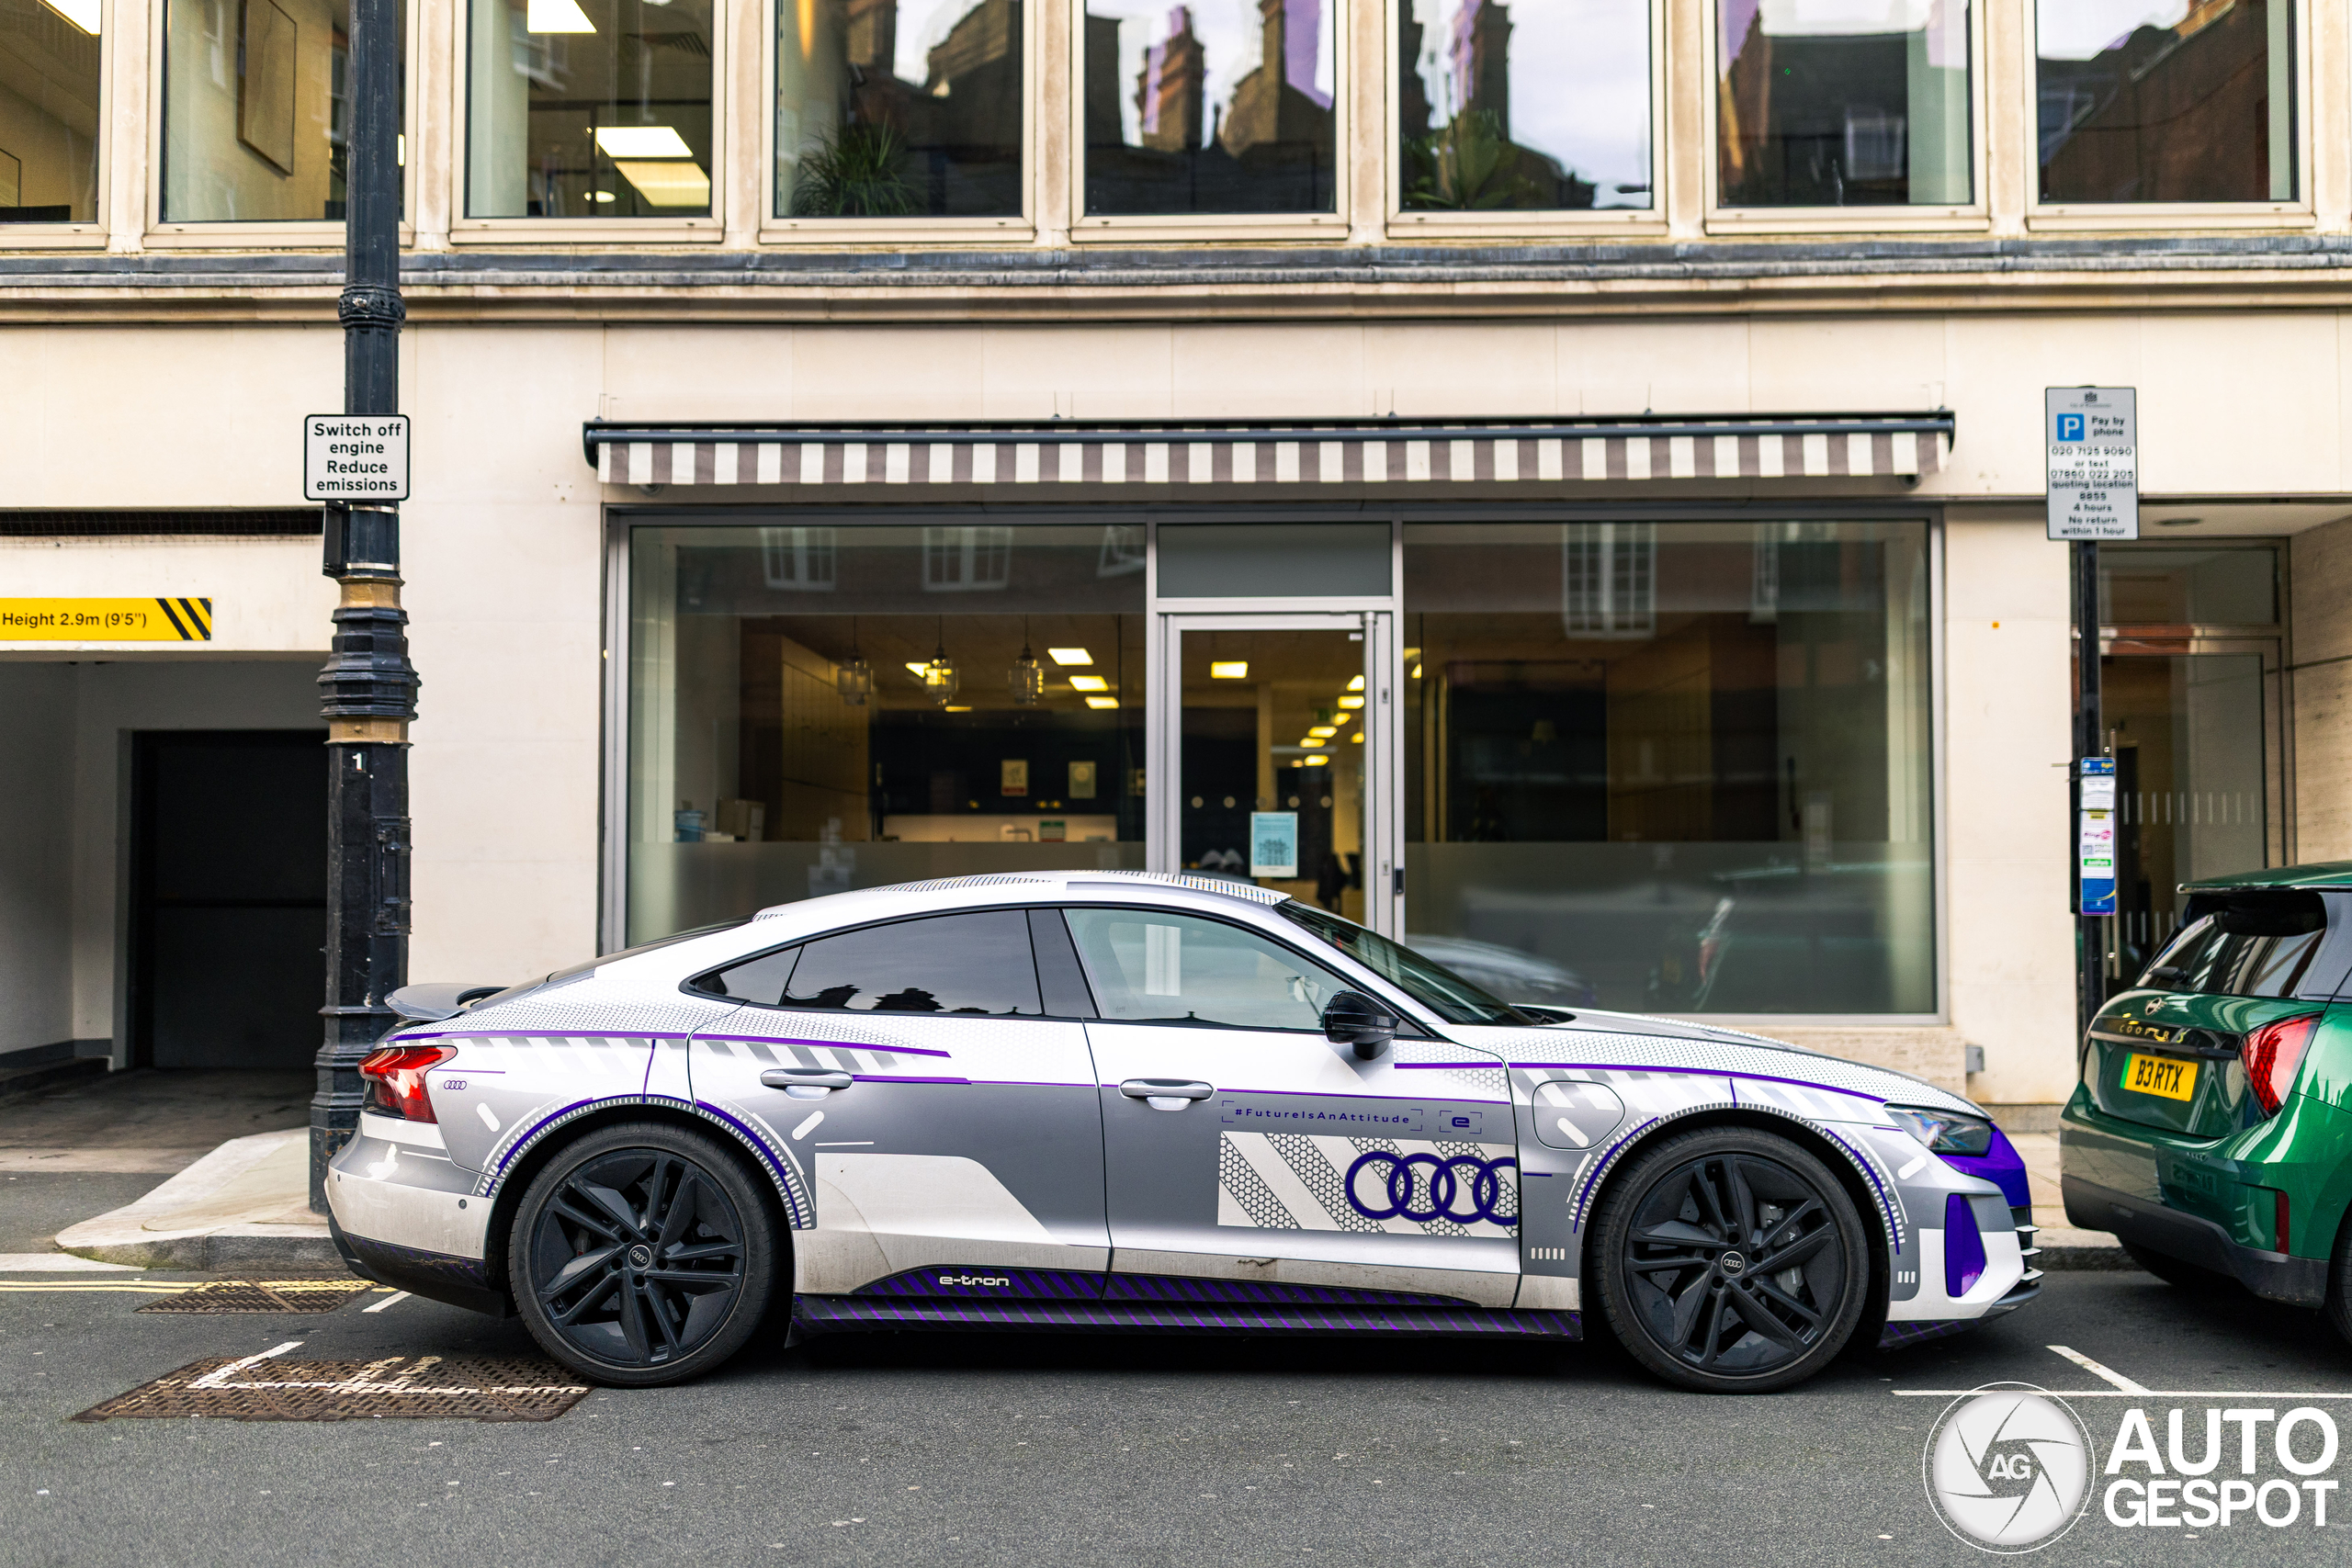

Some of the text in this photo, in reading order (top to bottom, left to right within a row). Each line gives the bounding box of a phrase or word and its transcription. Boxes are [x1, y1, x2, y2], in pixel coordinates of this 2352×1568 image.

[2091, 415, 2125, 426] Pay by
[313, 423, 401, 436] Switch off
[2093, 428, 2124, 437] phone
[330, 440, 384, 456] engine
[2052, 446, 2073, 456] 020
[2076, 446, 2100, 456] 7125
[327, 460, 388, 473] Reduce
[2088, 469, 2109, 479] 022
[2113, 469, 2134, 479] 205
[316, 478, 398, 491] emissions
[2052, 479, 2133, 490] quoting location
[2074, 502, 2112, 512] 4 hours
[2068, 515, 2118, 525] No return
[2062, 527, 2092, 536] within
[2103, 527, 2125, 536] hour
[2, 613, 55, 629] Height
[60, 613, 100, 626] 2.9m
[352, 752, 363, 771] 1
[2135, 1060, 2184, 1093] B3 RTX
[1235, 1108, 1410, 1124] #FutureIsAnAttitude
[939, 1275, 1010, 1286] e-tron
